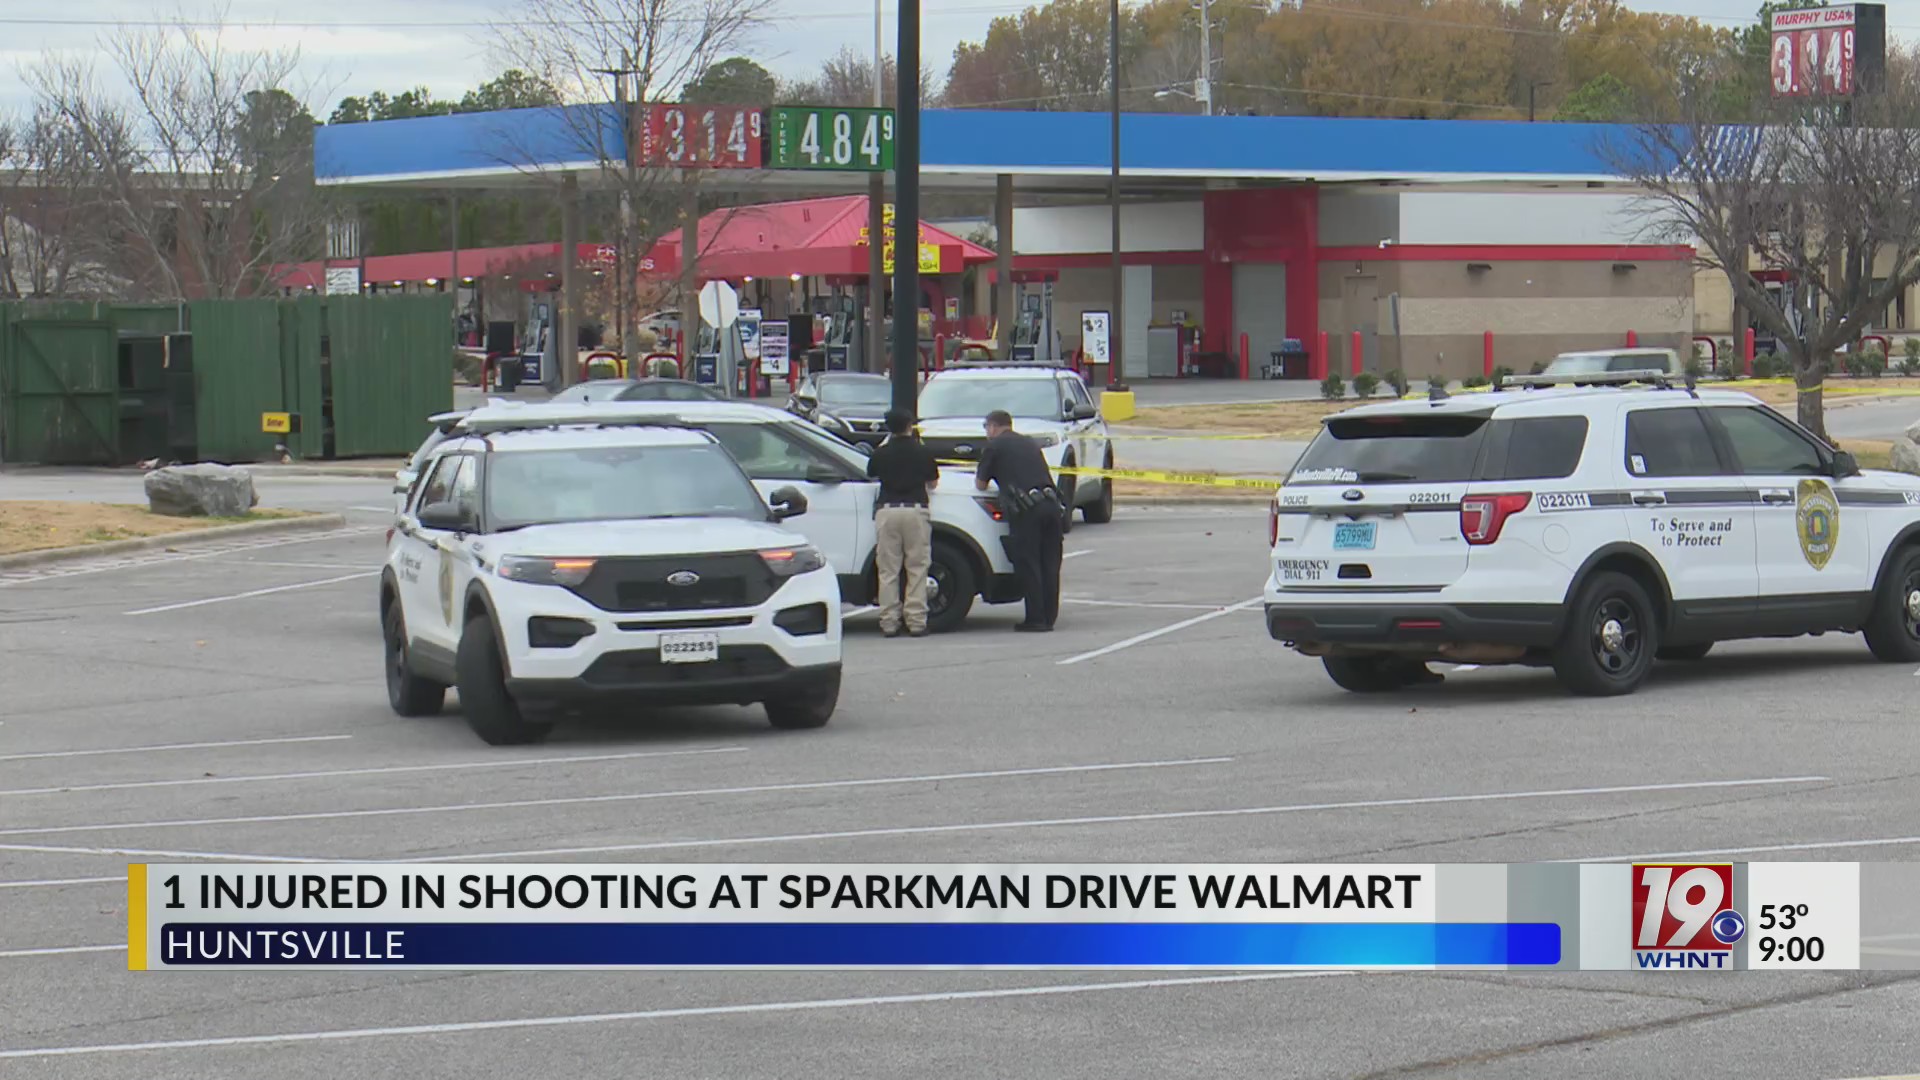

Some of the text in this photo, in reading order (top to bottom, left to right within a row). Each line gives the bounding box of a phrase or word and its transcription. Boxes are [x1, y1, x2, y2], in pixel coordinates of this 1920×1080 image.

[1775, 10, 1846, 26] MURPHY USA
[778, 112, 788, 164] DIESEL
[1283, 495, 1309, 505] POLICE
[1409, 493, 1451, 503] 022011
[1540, 493, 1587, 508] 022011
[1650, 517, 1733, 533] To Serve and
[1661, 534, 1723, 547] to Protect
[1278, 559, 1329, 571] EMERGENCY
[1284, 570, 1321, 581] DIAL 911
